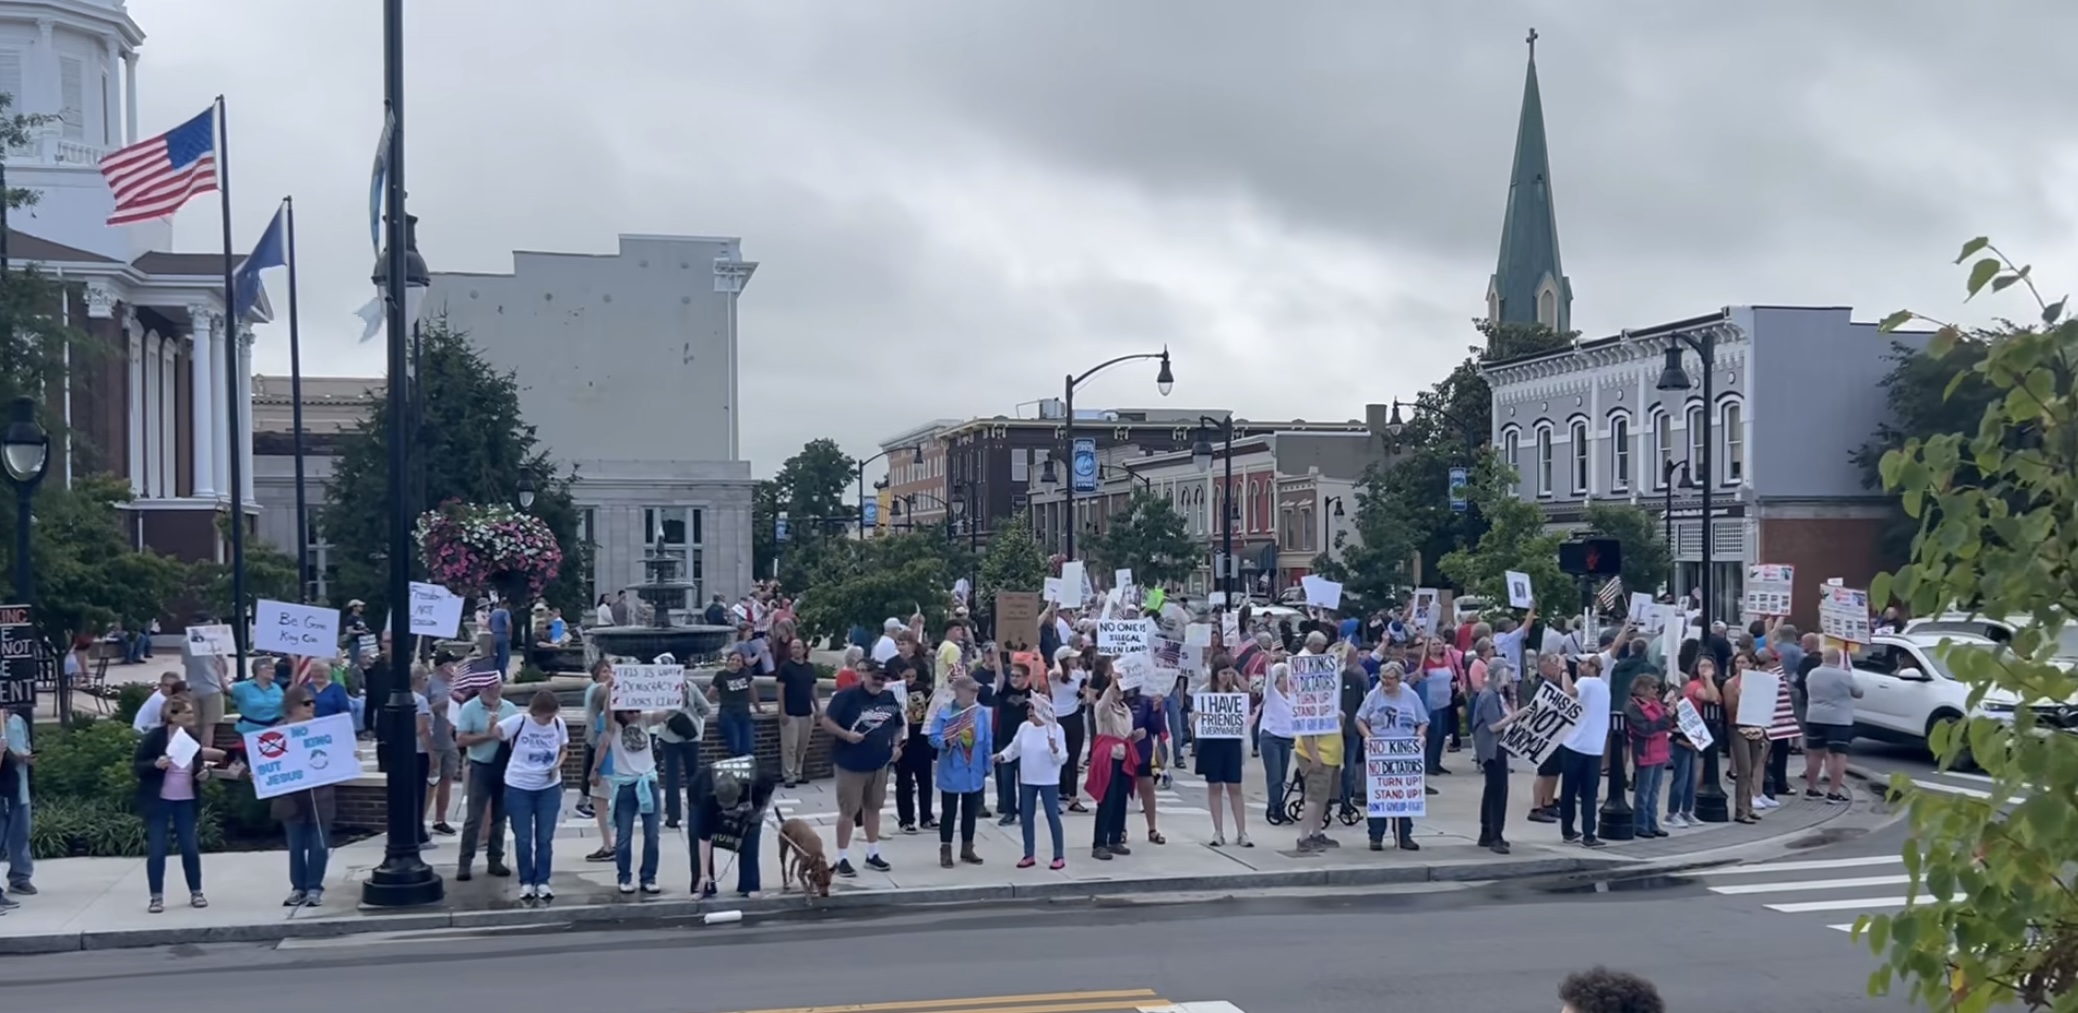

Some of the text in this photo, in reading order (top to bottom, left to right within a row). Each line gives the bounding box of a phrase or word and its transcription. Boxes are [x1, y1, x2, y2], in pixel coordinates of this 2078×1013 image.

[278, 612, 298, 627] Be
[1099, 622, 1146, 633] NO ONE IS
[1109, 634, 1141, 643] ILLEGAL
[2, 639, 32, 655] NOT
[1125, 645, 1147, 654] LAND
[1201, 696, 1242, 713] I HAVE
[1541, 684, 1583, 720] THIS IS
[1201, 713, 1244, 727] FRIENDS
[1519, 699, 1576, 741] NOT
[289, 726, 308, 738] NO
[1201, 726, 1243, 735] EVERYWHERE
[303, 734, 333, 749] KING
[1369, 739, 1421, 754] NO KINGS
[1501, 722, 1549, 766] NORMAL
[257, 760, 282, 776] BUT
[1369, 760, 1424, 775] NO DICTATORS
[265, 769, 304, 786] JESUS
[1377, 777, 1403, 787] TURN
[1374, 790, 1405, 800] STAND
